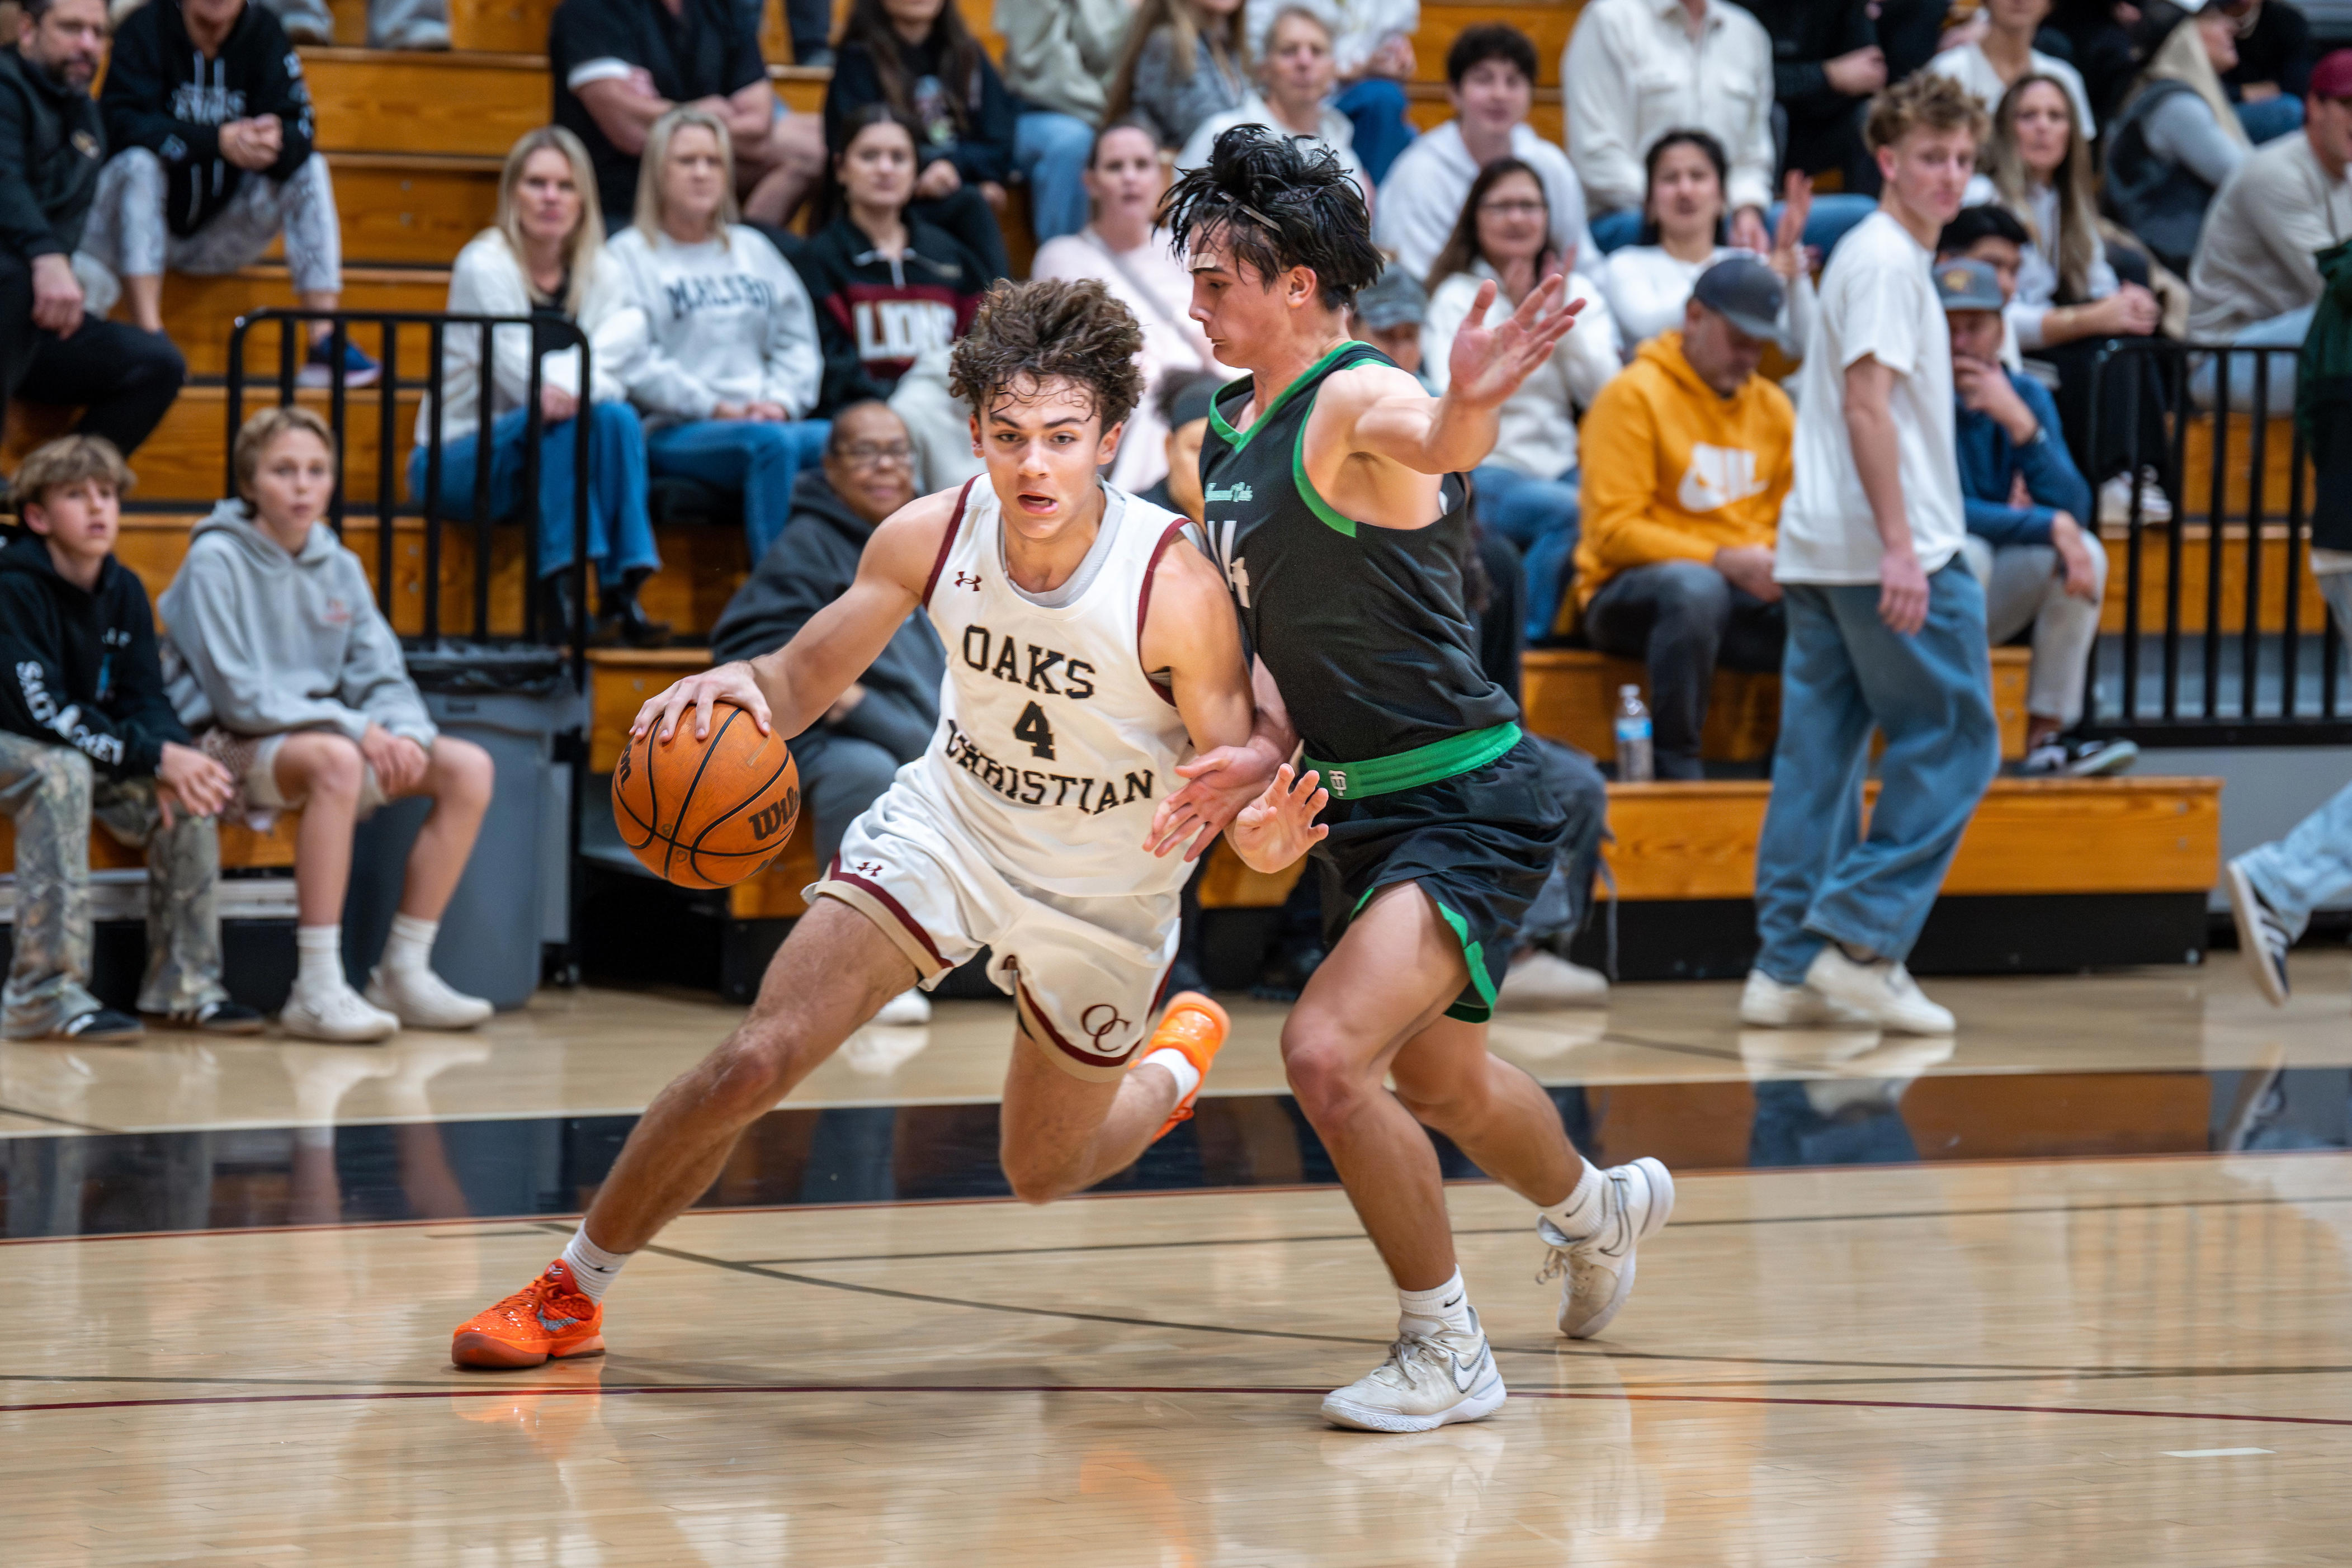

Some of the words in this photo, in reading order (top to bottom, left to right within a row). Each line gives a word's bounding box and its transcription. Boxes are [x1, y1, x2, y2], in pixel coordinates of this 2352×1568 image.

[963, 624, 1096, 699] OAKS
[946, 719, 1154, 815] CHRISTIAN
[1013, 700, 1056, 761] 4
